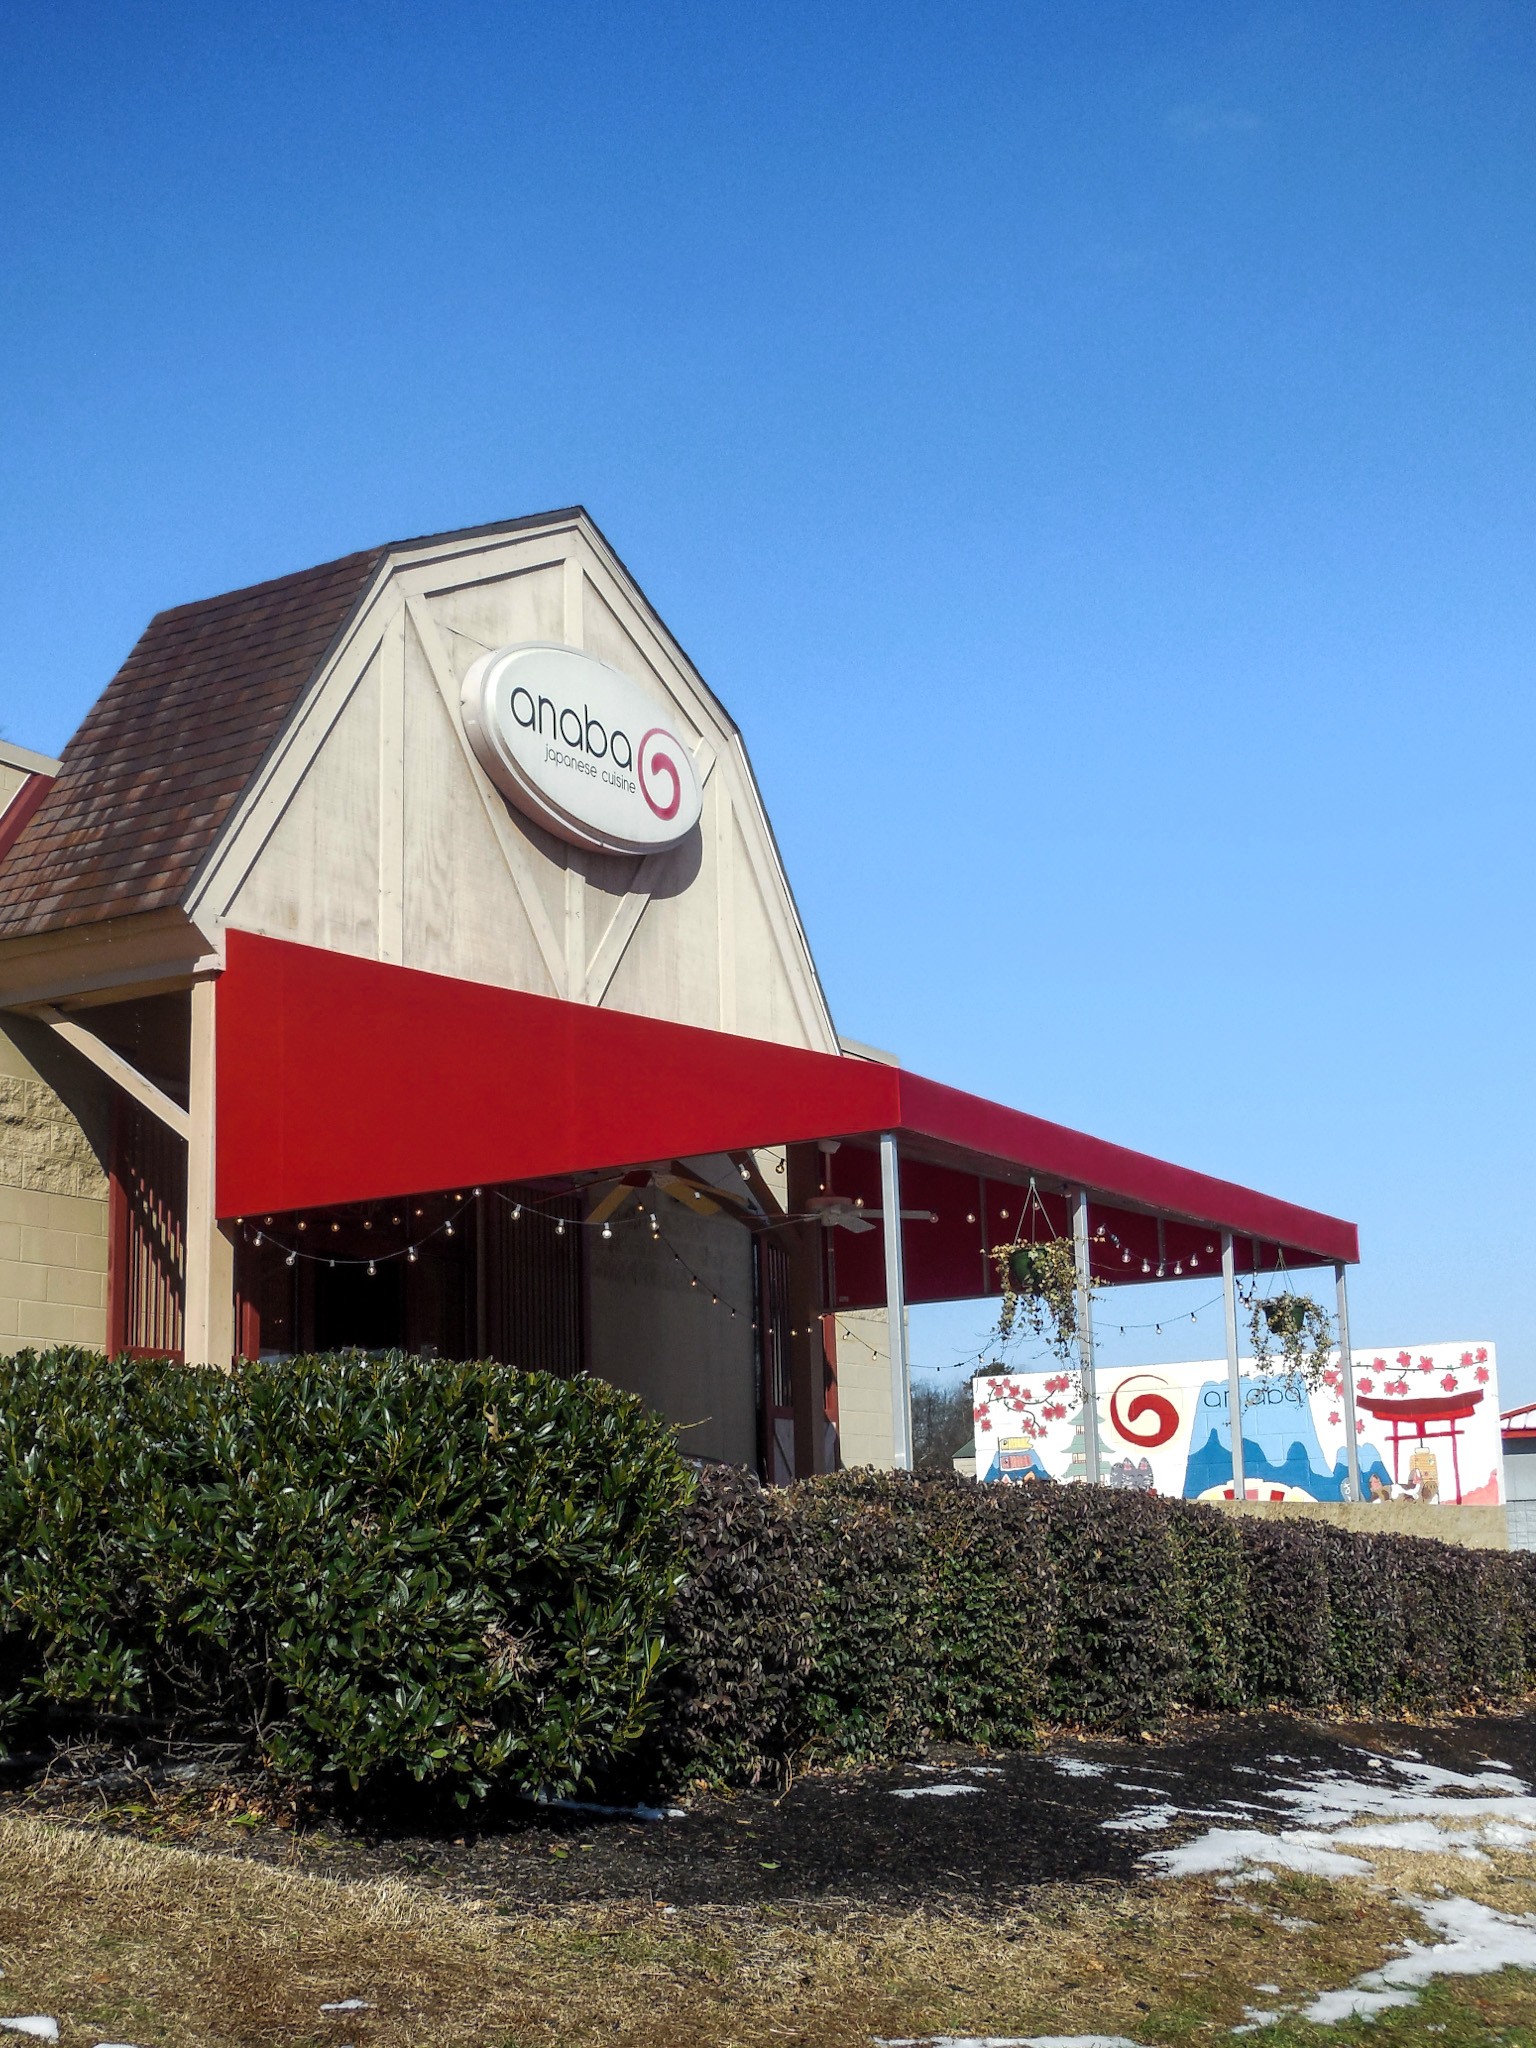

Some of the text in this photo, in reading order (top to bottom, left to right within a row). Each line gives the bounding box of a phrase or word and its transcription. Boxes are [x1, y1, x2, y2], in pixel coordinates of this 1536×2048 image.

[510, 687, 633, 772] anaba
[544, 743, 636, 794] japanese cuisine
